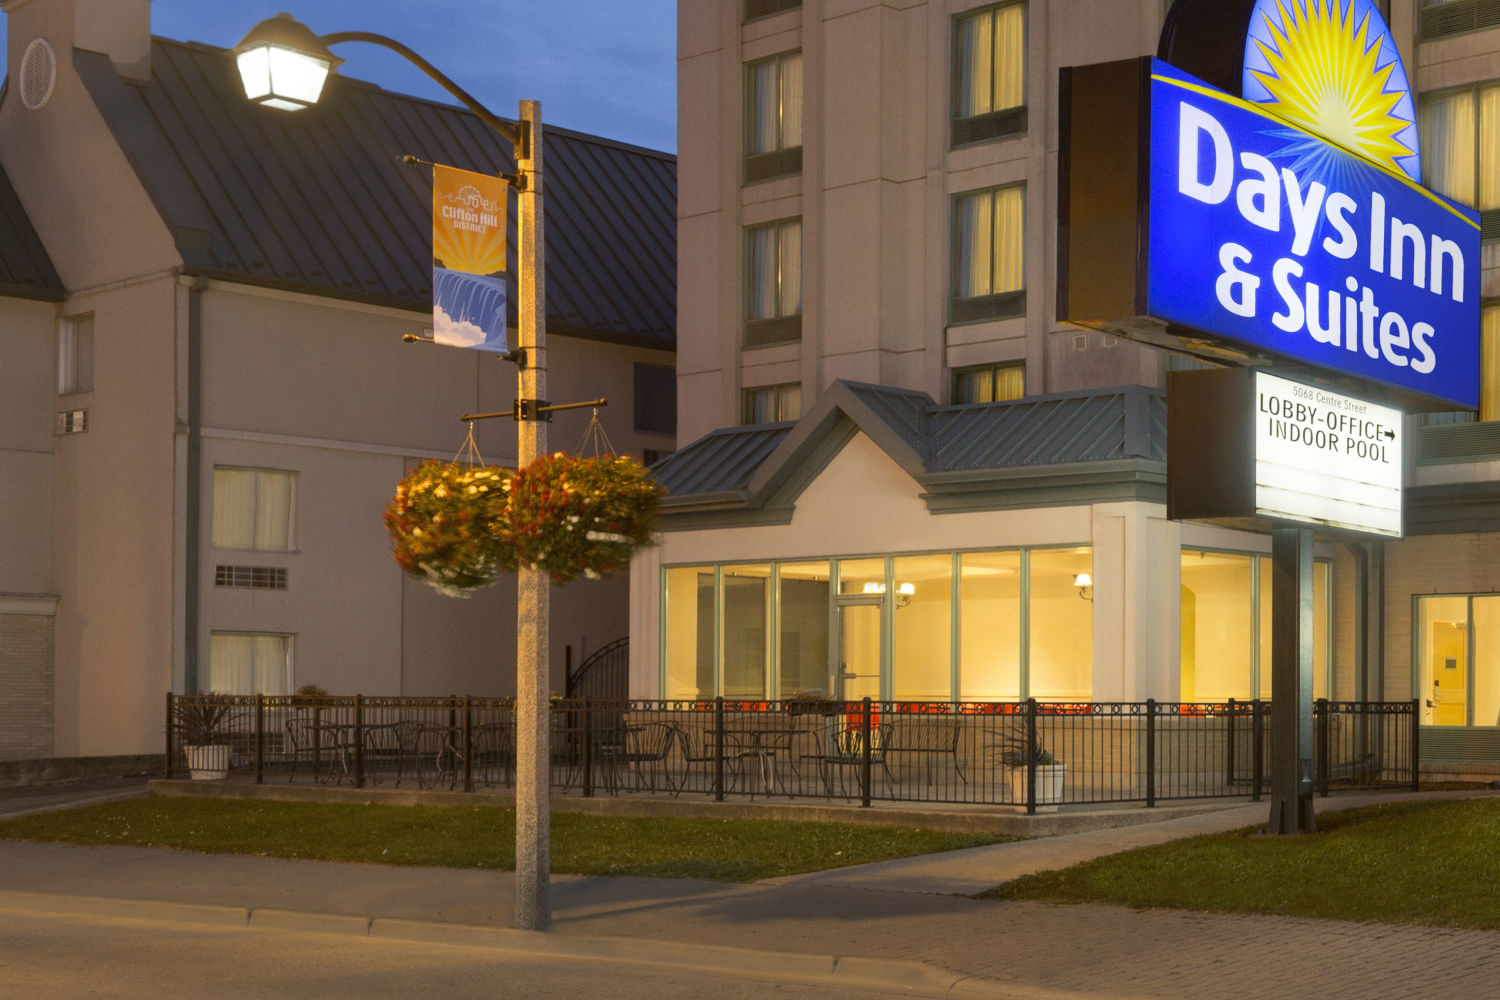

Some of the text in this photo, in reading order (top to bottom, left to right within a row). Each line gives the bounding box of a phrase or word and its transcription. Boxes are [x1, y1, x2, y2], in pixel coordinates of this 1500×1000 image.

[442, 205, 498, 227] Clifton Hill
[1178, 100, 1465, 303] Days Inn
[453, 220, 486, 233] DISTRICT
[1215, 242, 1436, 375] & Suites
[1260, 393, 1384, 442] LOBBY-OFFICE
[1293, 386, 1367, 415] 5068 Centre Street
[1269, 418, 1389, 463] INDOOR POOL
